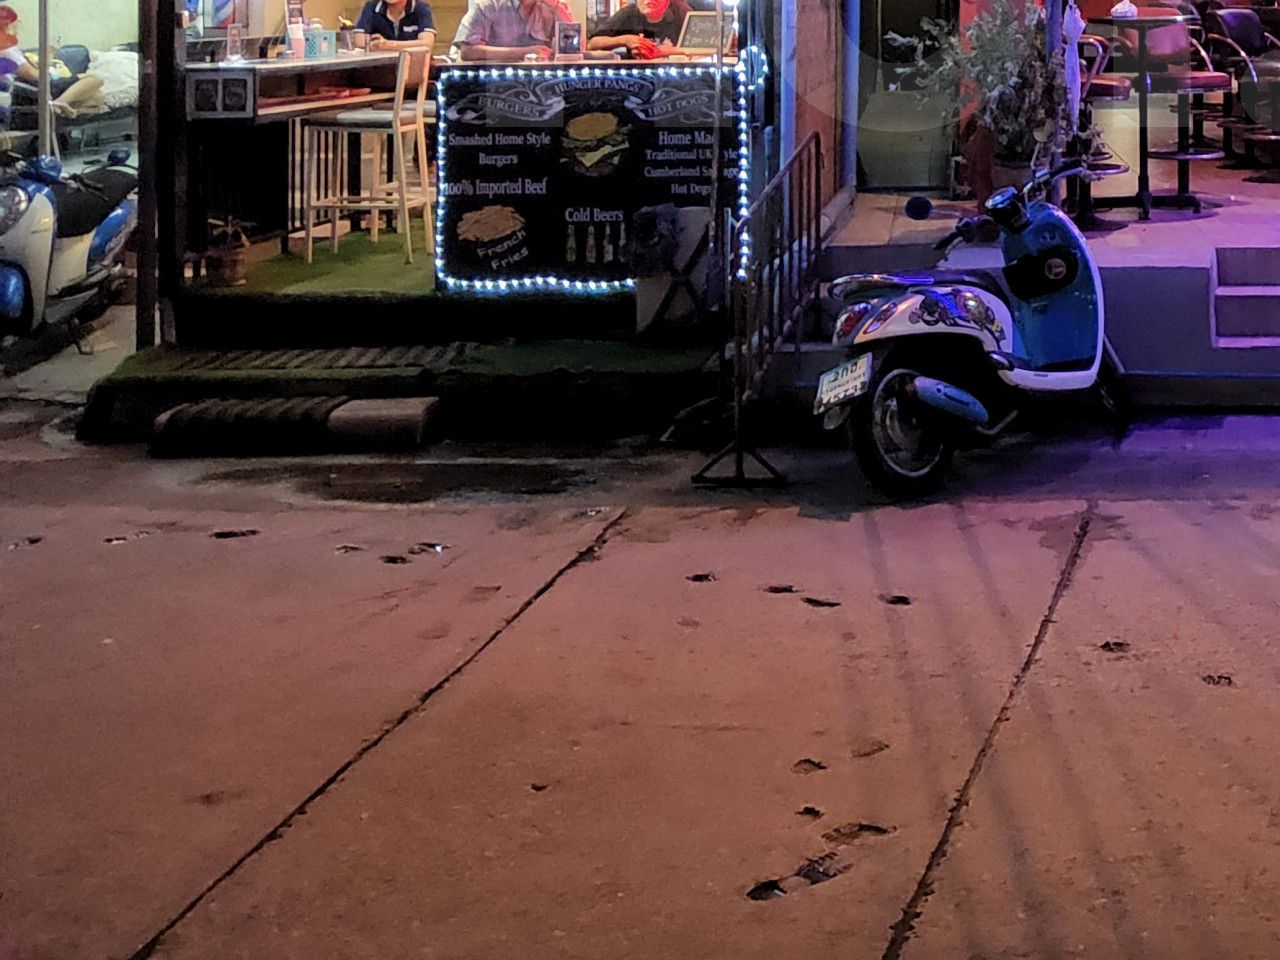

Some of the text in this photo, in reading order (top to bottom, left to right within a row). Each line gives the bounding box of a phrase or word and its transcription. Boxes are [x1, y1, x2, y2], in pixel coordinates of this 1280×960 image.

[554, 80, 640, 93] HUNGER PANGS
[478, 96, 540, 118] BURGERS
[650, 94, 709, 116] HOT DOGS
[449, 132, 551, 147] Smashed Home Style
[659, 131, 691, 144] Home
[479, 152, 518, 167] Burgers
[645, 149, 697, 160] Traditional
[644, 166, 700, 178] Cumberland
[476, 178, 522, 198] Imported
[525, 177, 547, 194] Beef
[671, 183, 687, 194] Hot
[565, 208, 624, 222] Cold Beers
[477, 230, 526, 258] French
[491, 247, 529, 270] Fries
